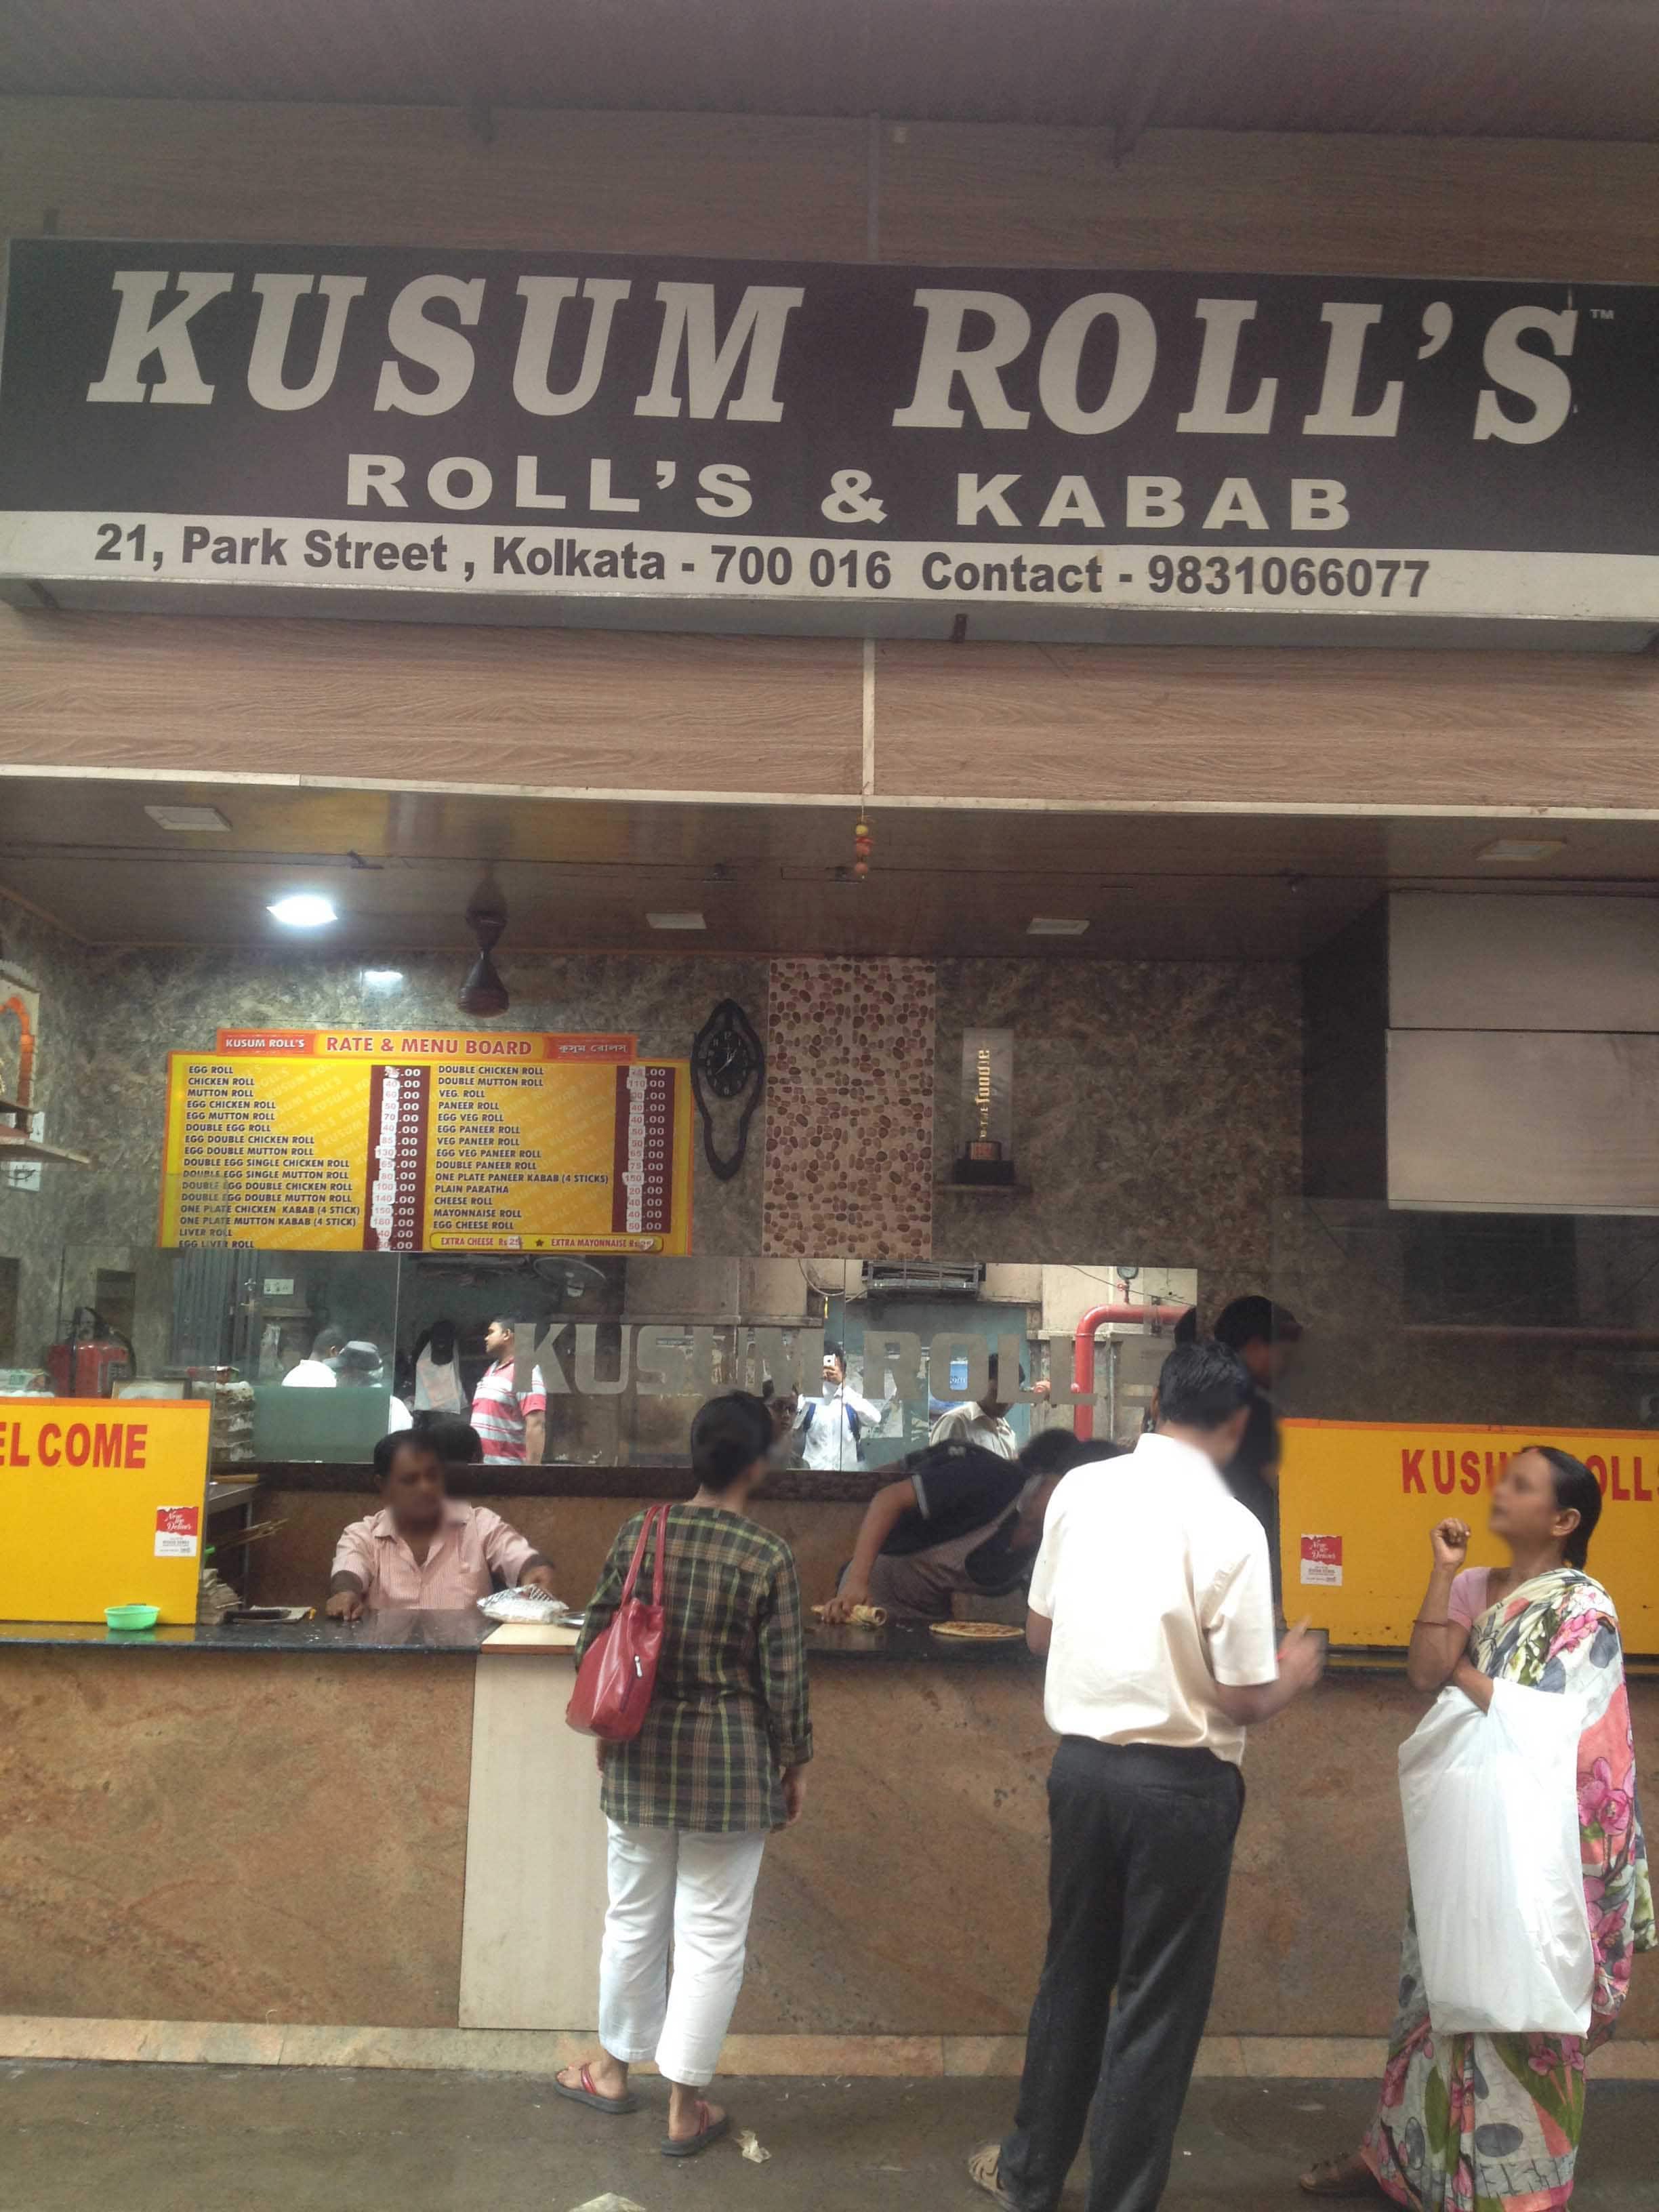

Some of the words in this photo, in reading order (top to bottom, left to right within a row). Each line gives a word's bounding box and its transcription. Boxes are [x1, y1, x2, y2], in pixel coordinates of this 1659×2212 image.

[86, 271, 805, 422] KUSUM
[892, 288, 1578, 445] ROLL'S
[347, 453, 754, 518] ROLL'S
[821, 468, 888, 524] &
[957, 472, 1350, 531] KABAB
[96, 523, 164, 571] 21,
[182, 525, 287, 567] Park
[493, 536, 665, 580] Kolkata
[810, 552, 892, 588] 016
[921, 551, 1104, 594] Contact
[226, 1039, 265, 1047] KUSUM
[269, 1039, 304, 1048] ROLL'S
[327, 1037, 373, 1051] RATE
[380, 1038, 394, 1052] &
[401, 1038, 458, 1053] MENU
[466, 1040, 532, 1054] BOARD
[189, 1066, 207, 1074] EGG
[211, 1066, 234, 1074] ROLL
[438, 1066, 475, 1075] DOUBLE
[478, 1066, 519, 1075] CHICKEN
[522, 1066, 544, 1075] ROLL
[188, 1078, 229, 1086] CHICKEN
[232, 1078, 255, 1086] ROLL
[438, 1078, 475, 1087] DOUBLE
[478, 1078, 518, 1087] MUTTON
[521, 1078, 544, 1087] ROLL
[187, 1089, 228, 1097] MUTTON
[231, 1089, 253, 1097] ROLL
[463, 1090, 485, 1098] ROLL
[187, 1101, 206, 1109] EGG
[209, 1101, 250, 1109] CHICKEN
[253, 1101, 276, 1109] ROLL
[438, 1101, 474, 1110] PANEER
[477, 1101, 499, 1110] ROLL
[186, 1112, 205, 1120] EGG
[209, 1112, 249, 1120] MUTTON
[253, 1112, 275, 1120] ROLL
[438, 1113, 457, 1122] EGG
[459, 1113, 478, 1122] VEG
[482, 1113, 504, 1122] ROLL
[186, 1124, 222, 1132] DOUBLE
[225, 1124, 245, 1132] EGG
[248, 1124, 271, 1132] ROLL
[437, 1126, 456, 1134] EGG
[459, 1126, 495, 1134] PANEER
[498, 1126, 520, 1134] ROLL
[184, 1135, 204, 1144] EGG
[207, 1135, 244, 1144] DOUBLE
[247, 1135, 289, 1144] CHICKEN
[291, 1135, 314, 1144] ROLL
[437, 1137, 456, 1146] VEG
[459, 1137, 495, 1146] PANEER
[497, 1137, 520, 1146] ROLL
[184, 1147, 203, 1155] EGG
[207, 1147, 244, 1155] DOUBLE
[247, 1147, 288, 1155] MUTTON
[291, 1147, 314, 1155] ROLL
[436, 1149, 455, 1158] EGG
[458, 1149, 477, 1158] VEG
[480, 1149, 516, 1158] PANEER
[519, 1149, 541, 1158] ROLL
[184, 1159, 221, 1168] DOUBLE
[224, 1159, 243, 1168] EGG
[246, 1159, 279, 1168] SINGLE
[283, 1159, 324, 1168] CHICKEN
[327, 1159, 350, 1168] ROLL
[436, 1161, 472, 1170] DOUBLE
[475, 1161, 511, 1170] PANEER
[514, 1161, 537, 1170] ROLL
[183, 1170, 220, 1179] DOUBLE
[223, 1170, 243, 1179] EGG
[246, 1170, 279, 1179] SINGLE
[282, 1170, 323, 1179] MUTTON
[326, 1170, 348, 1179] ROLL
[435, 1173, 455, 1184] ONE
[457, 1173, 485, 1184] PLATE
[488, 1173, 524, 1184] PANEER
[527, 1173, 559, 1184] KABAB
[562, 1173, 571, 1184] (4
[573, 1173, 609, 1184] STICKS)
[182, 1182, 219, 1191] DOUBLE
[222, 1182, 242, 1191] EGG
[245, 1182, 282, 1191] DOUBLE
[285, 1182, 327, 1191] CHICKEN
[330, 1182, 352, 1191] ROLL
[434, 1185, 462, 1194] PLAIN
[466, 1185, 509, 1194] PARATHA
[181, 1193, 219, 1203] DOUBLE
[222, 1193, 241, 1203] EGG
[245, 1193, 281, 1203] DOUBLE
[285, 1193, 325, 1203] MUTTON
[329, 1193, 352, 1203] ROLL
[434, 1197, 468, 1206] CHEESE
[470, 1197, 493, 1206] ROLL
[180, 1205, 200, 1214] ONE
[203, 1205, 232, 1214] PLATE
[234, 1205, 276, 1214] CHICKEN
[282, 1205, 314, 1214] KABAB
[317, 1205, 327, 1214] (4
[329, 1205, 360, 1214] STICK)
[433, 1209, 496, 1218] MAYONNAISE
[499, 1209, 522, 1218] ROLL
[180, 1216, 200, 1227] ONE
[203, 1216, 231, 1227] PLATE
[234, 1216, 275, 1227] MUTTON
[278, 1216, 310, 1227] KABAB
[314, 1216, 323, 1227] (4
[326, 1216, 356, 1227] STICK)
[433, 1221, 452, 1230] EGG
[455, 1221, 489, 1230] CHEESE
[492, 1221, 514, 1230] ROLL
[179, 1228, 207, 1237] LIVER
[209, 1228, 232, 1237] ROLL
[178, 1240, 198, 1248] EGG
[201, 1240, 228, 1248] LIVER
[231, 1240, 254, 1248] ROLL
[441, 1237, 464, 1246] EXTRA
[468, 1237, 493, 1246] CHEESE
[577, 1239, 626, 1248] MAYONNAISE
[514, 1323, 825, 1397] KUSUM
